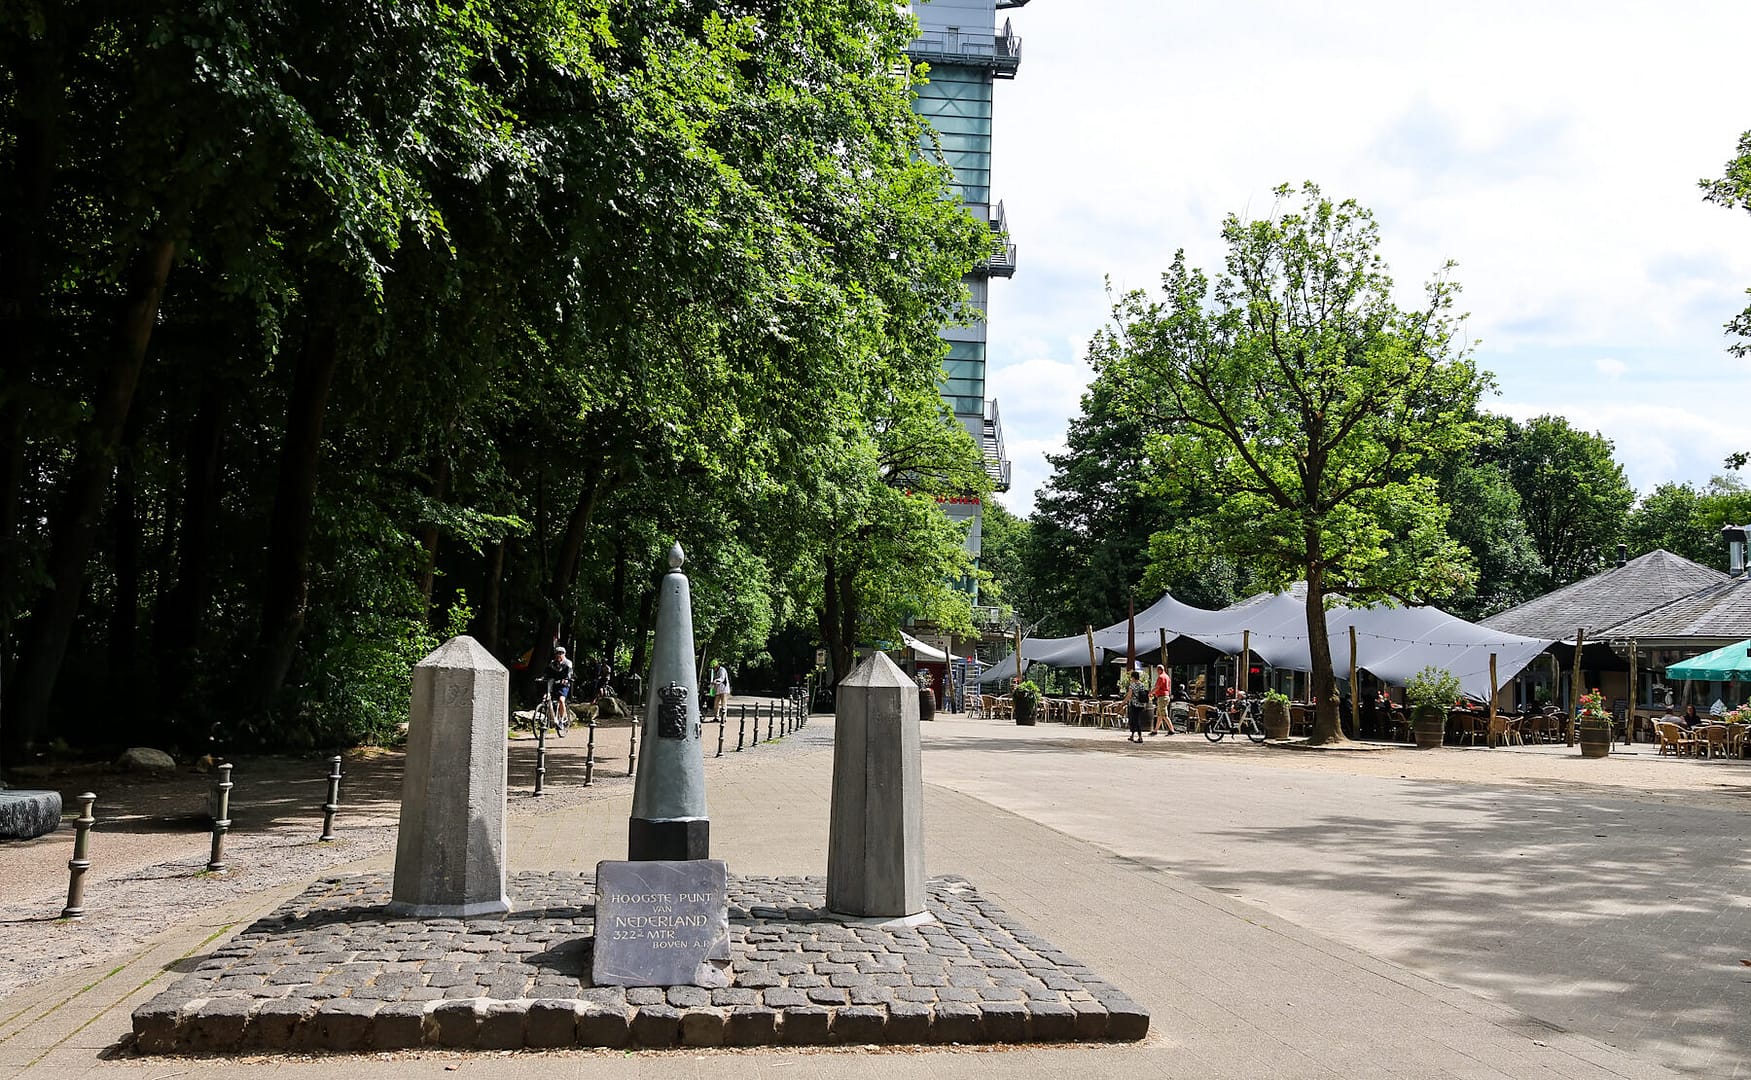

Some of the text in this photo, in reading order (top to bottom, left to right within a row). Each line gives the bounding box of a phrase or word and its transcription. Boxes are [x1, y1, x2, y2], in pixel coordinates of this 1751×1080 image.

[611, 893, 712, 904] HOOGSTE PUNT
[653, 905, 672, 913] VAN
[615, 915, 708, 928] NEDERLAND
[653, 941, 688, 949] BOVEN
